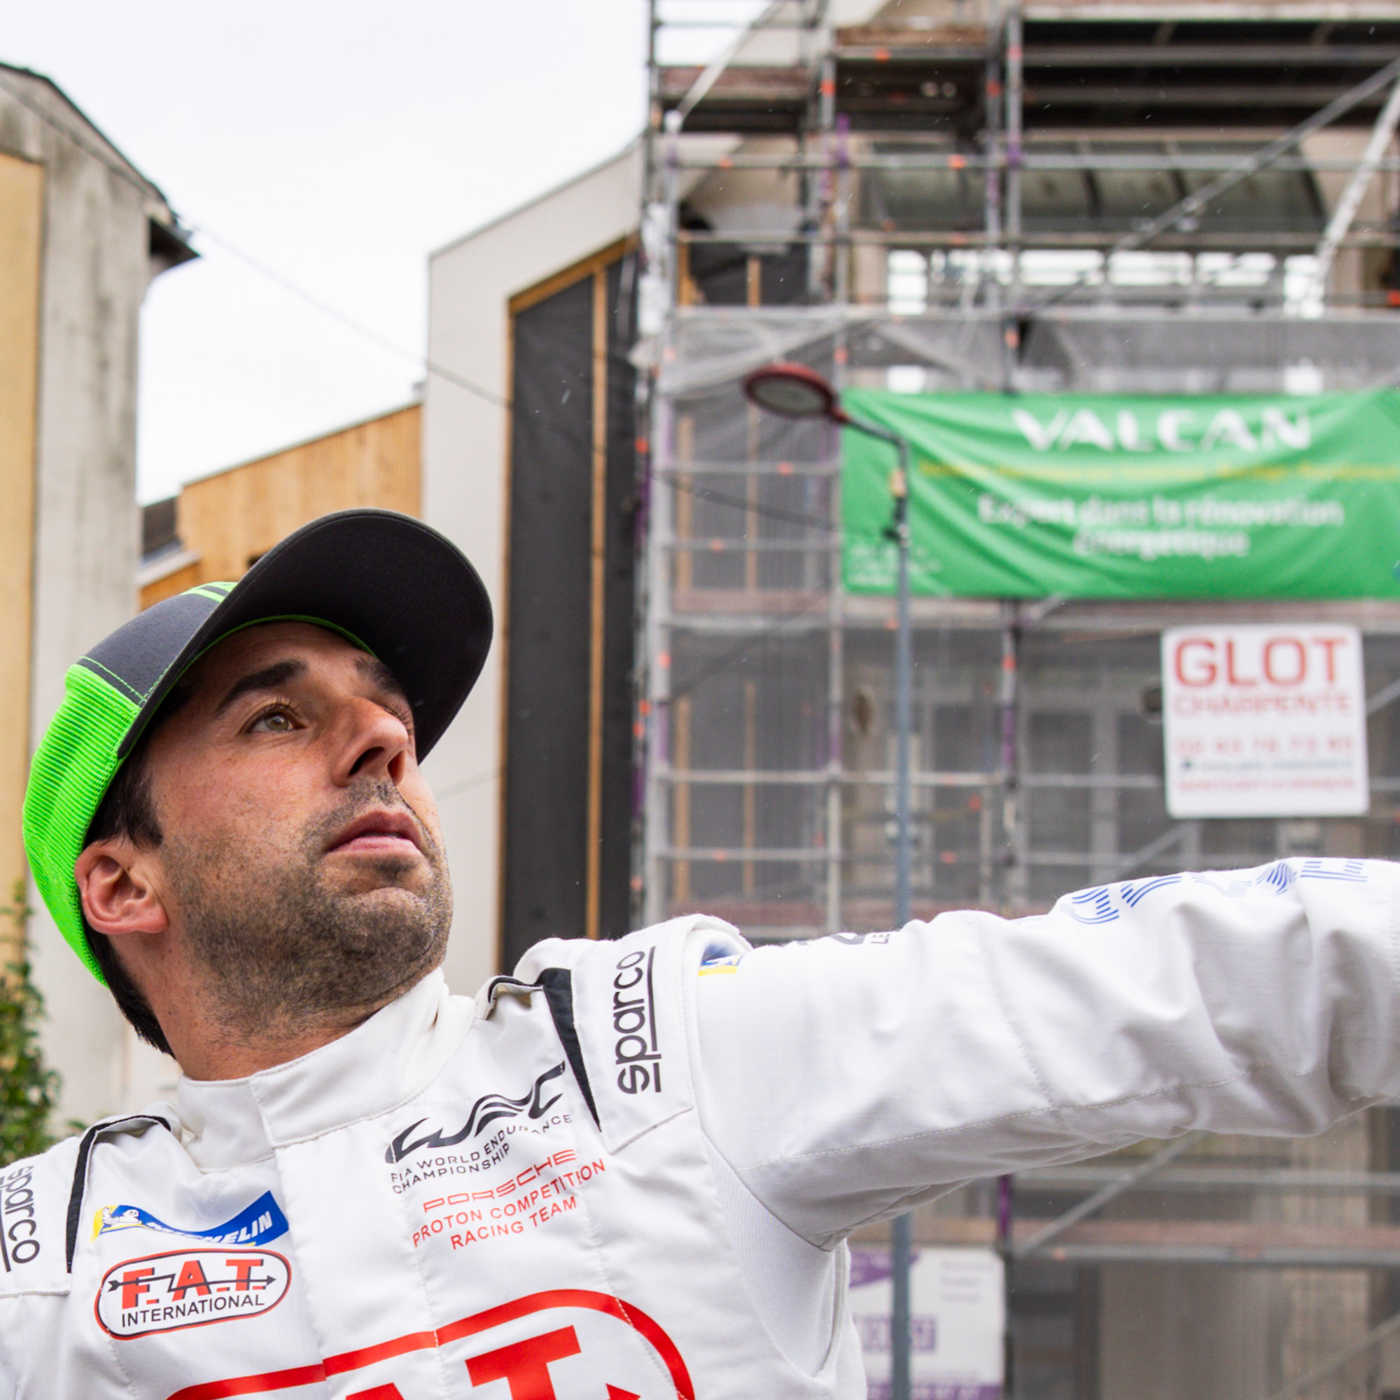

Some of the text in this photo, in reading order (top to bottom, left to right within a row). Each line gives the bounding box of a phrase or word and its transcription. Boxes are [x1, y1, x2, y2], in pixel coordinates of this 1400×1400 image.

[1011, 406, 1312, 453] VALCAN
[1174, 636, 1348, 688] GLOT
[613, 950, 662, 1095] sparco
[391, 1167, 412, 1183] FIA
[416, 1151, 480, 1169] WORLD
[391, 1142, 510, 1195] CHAMPIONSHIP
[423, 1149, 577, 1214] PORSCHE
[412, 1158, 606, 1248] PROTON COMPETITION
[450, 1195, 577, 1250] RACING TEAM
[121, 1294, 265, 1328] INTERNATIONAL
